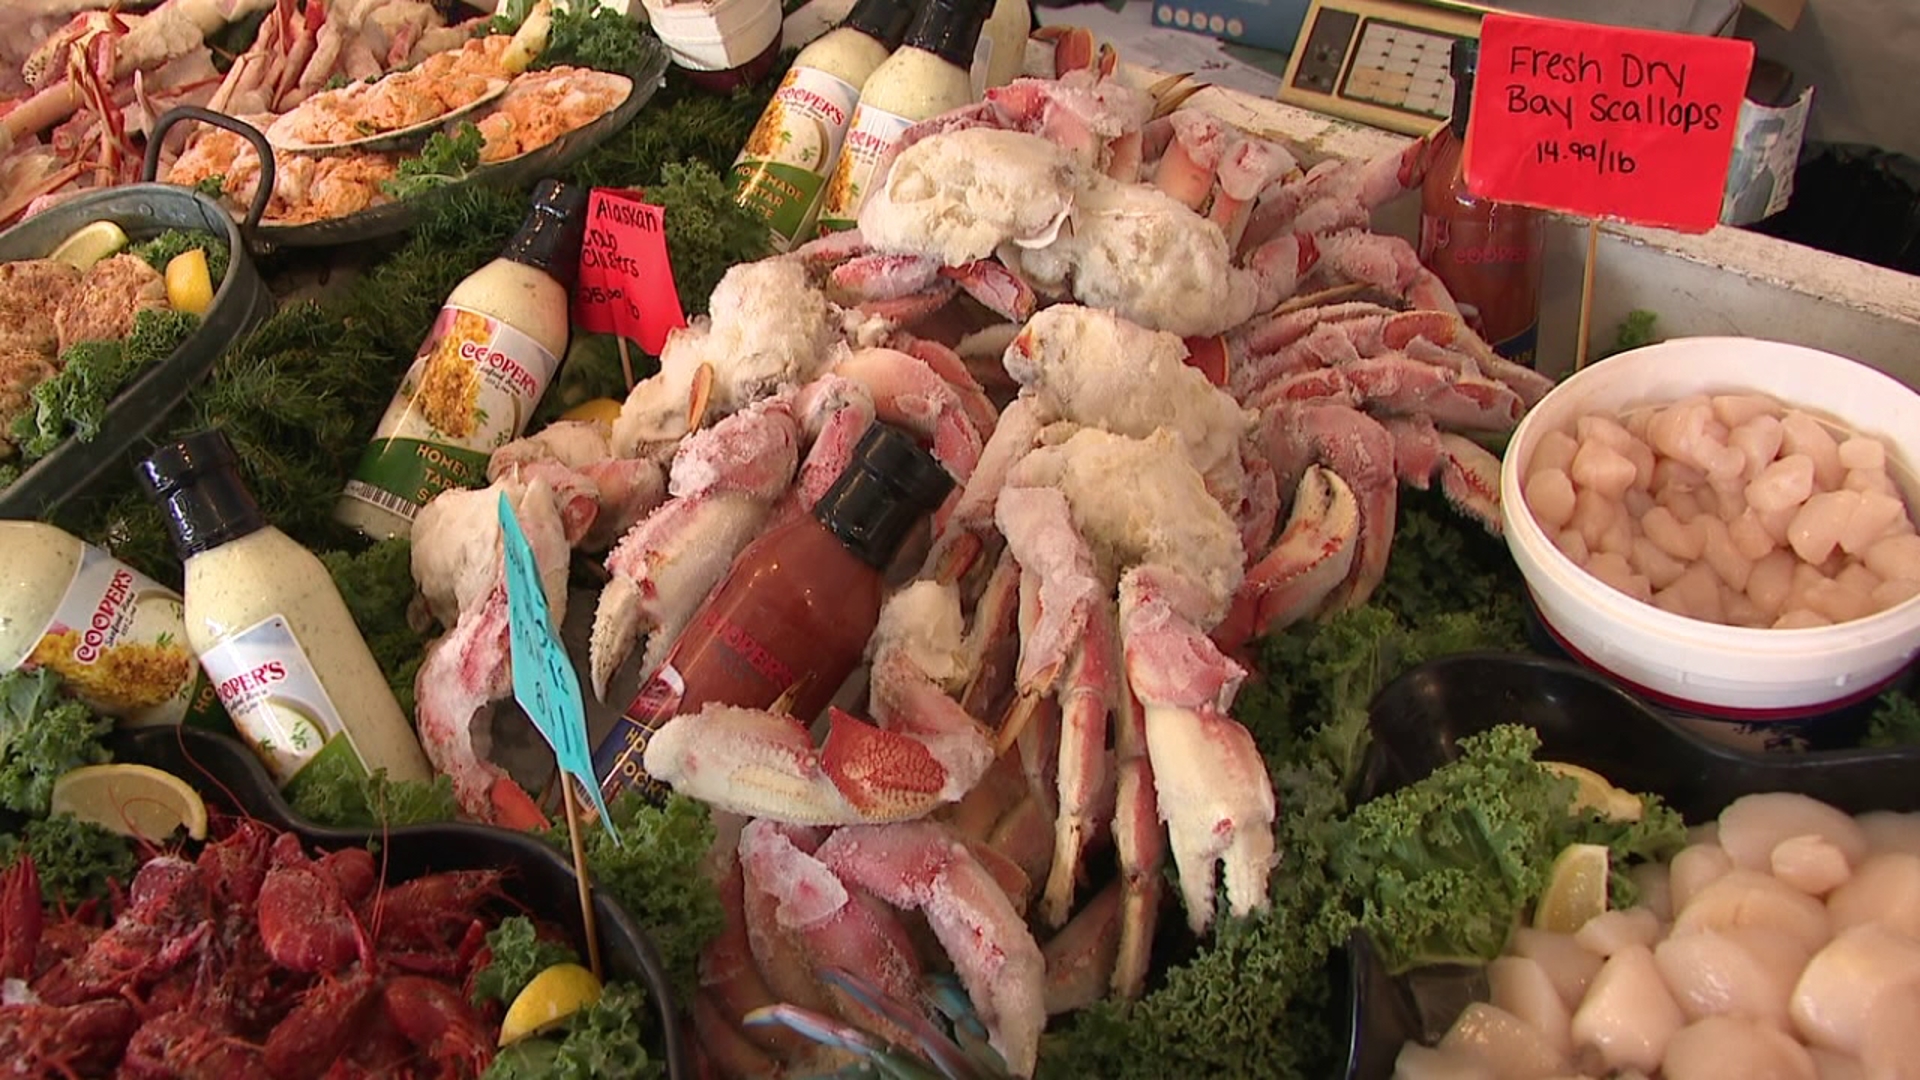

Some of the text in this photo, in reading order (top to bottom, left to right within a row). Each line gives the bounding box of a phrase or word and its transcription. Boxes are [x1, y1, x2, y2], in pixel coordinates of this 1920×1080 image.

[1511, 46, 1686, 97] Fresh Dry
[1506, 85, 1722, 133] Bay Scallops
[1537, 140, 1636, 174] 14.99/lb
[596, 198, 658, 232] Alaskan
[77, 568, 134, 663] COOPER'S
[217, 661, 286, 703] OPER'S
[625, 727, 646, 750] HO
